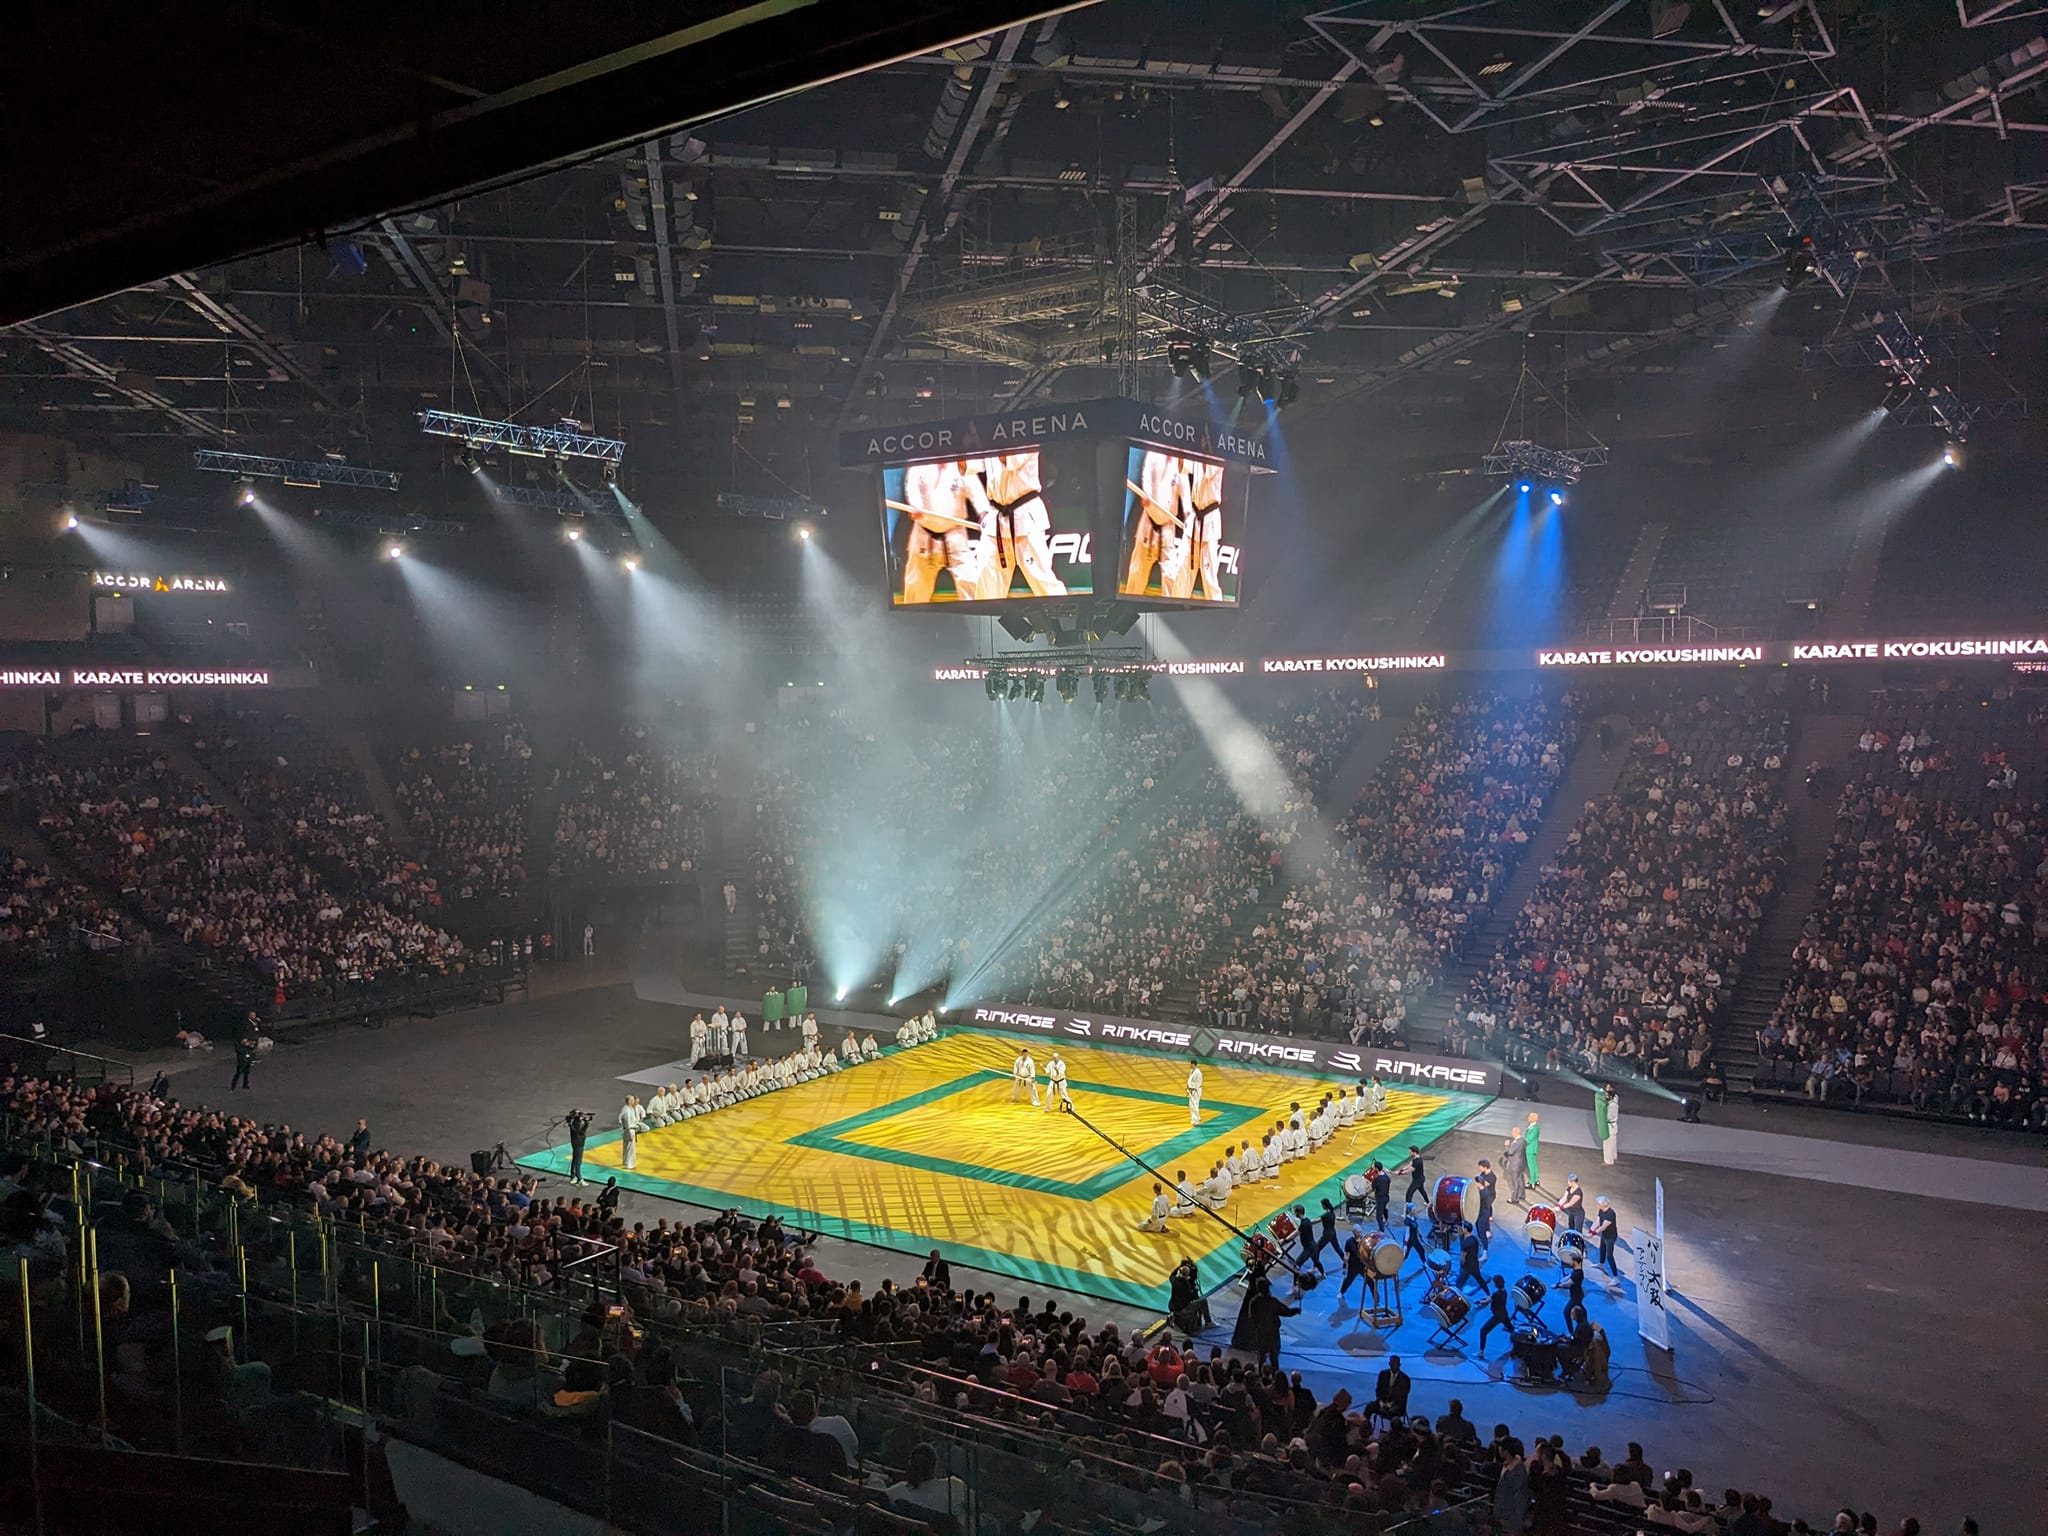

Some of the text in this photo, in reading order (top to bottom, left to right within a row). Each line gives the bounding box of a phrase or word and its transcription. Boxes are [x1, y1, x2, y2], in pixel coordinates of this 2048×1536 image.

[867, 412, 1088, 455] ACCOR ARENA
[1139, 413, 1265, 459] ACCOR ARENA
[172, 577, 227, 591] ARENA
[1539, 647, 1762, 665] KARATE KYOKUSHINKAI
[1793, 639, 2048, 659] KARATE KYOKUSHINKA
[1264, 656, 1445, 672] KARATE KYOKUSHINKAI
[73, 671, 269, 685] KARATE KYOKUSHINKAI
[935, 669, 980, 680] KARATE
